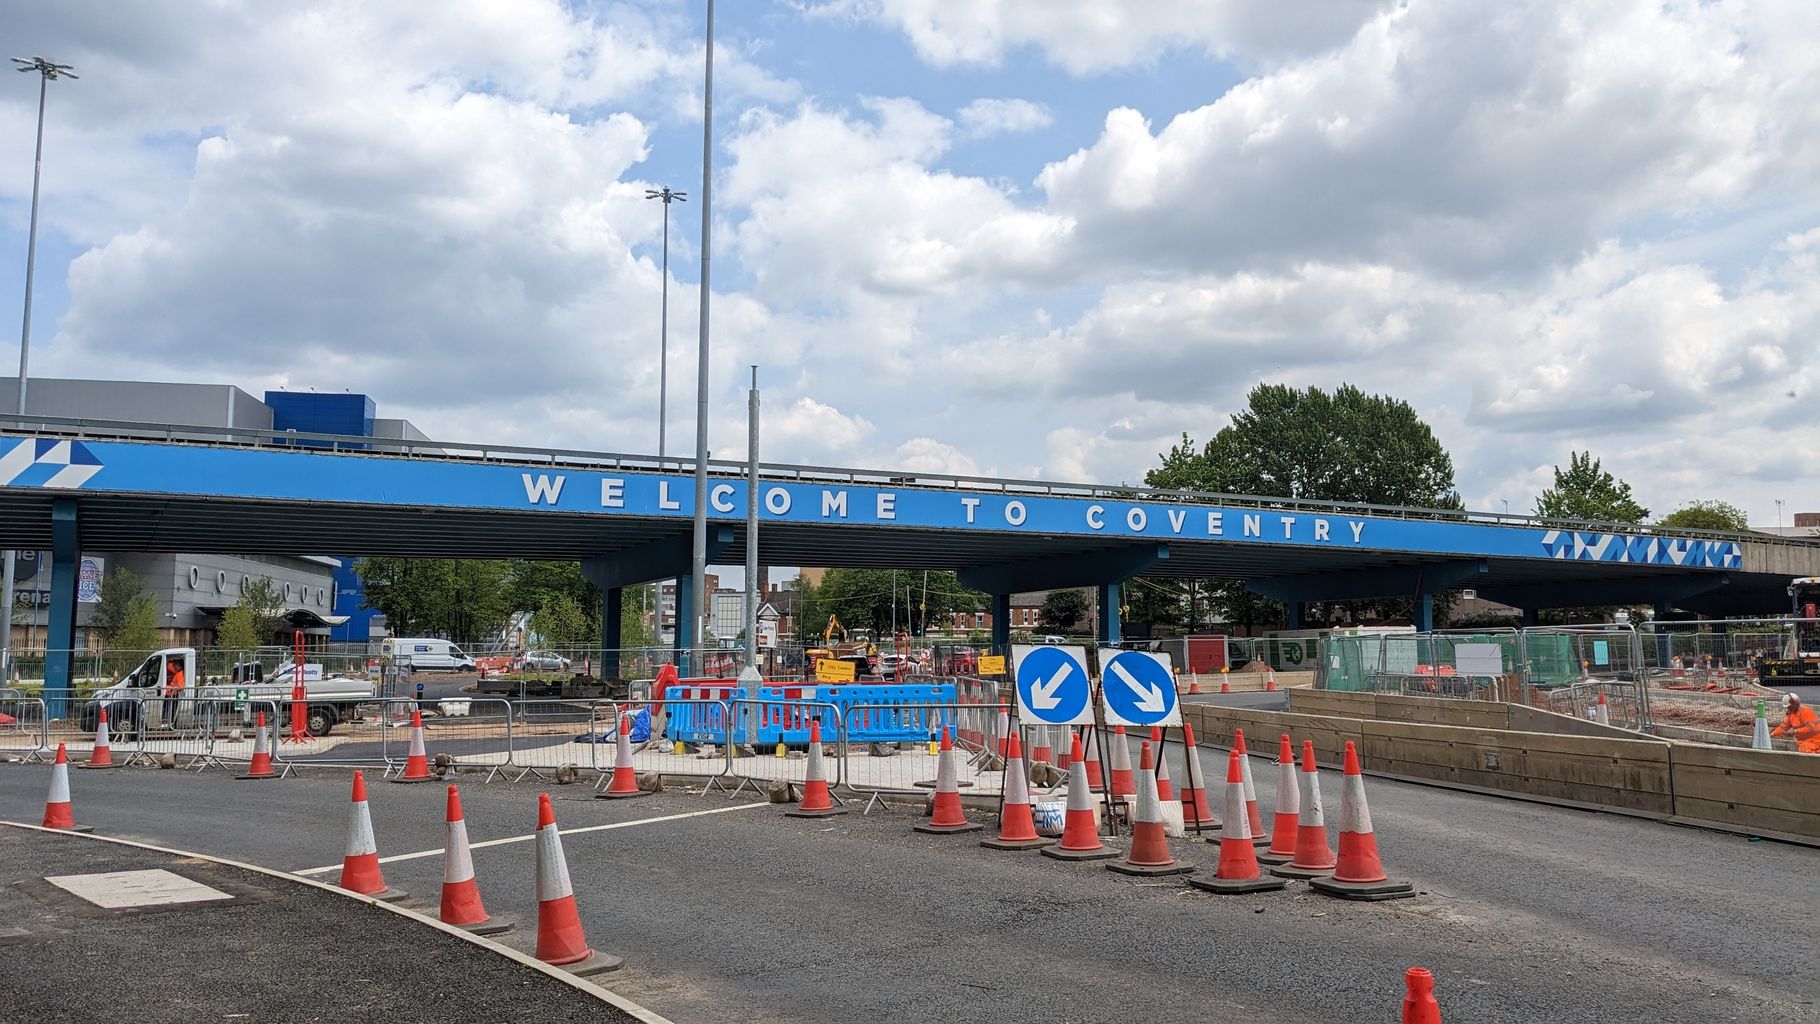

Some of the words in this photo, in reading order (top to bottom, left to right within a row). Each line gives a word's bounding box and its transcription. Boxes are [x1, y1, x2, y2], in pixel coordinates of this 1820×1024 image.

[521, 473, 897, 520] WELCOME
[961, 498, 1028, 527] TO
[1086, 505, 1365, 544] COVENTRY
[79, 580, 96, 591] ICE
[14, 591, 51, 604] rena
